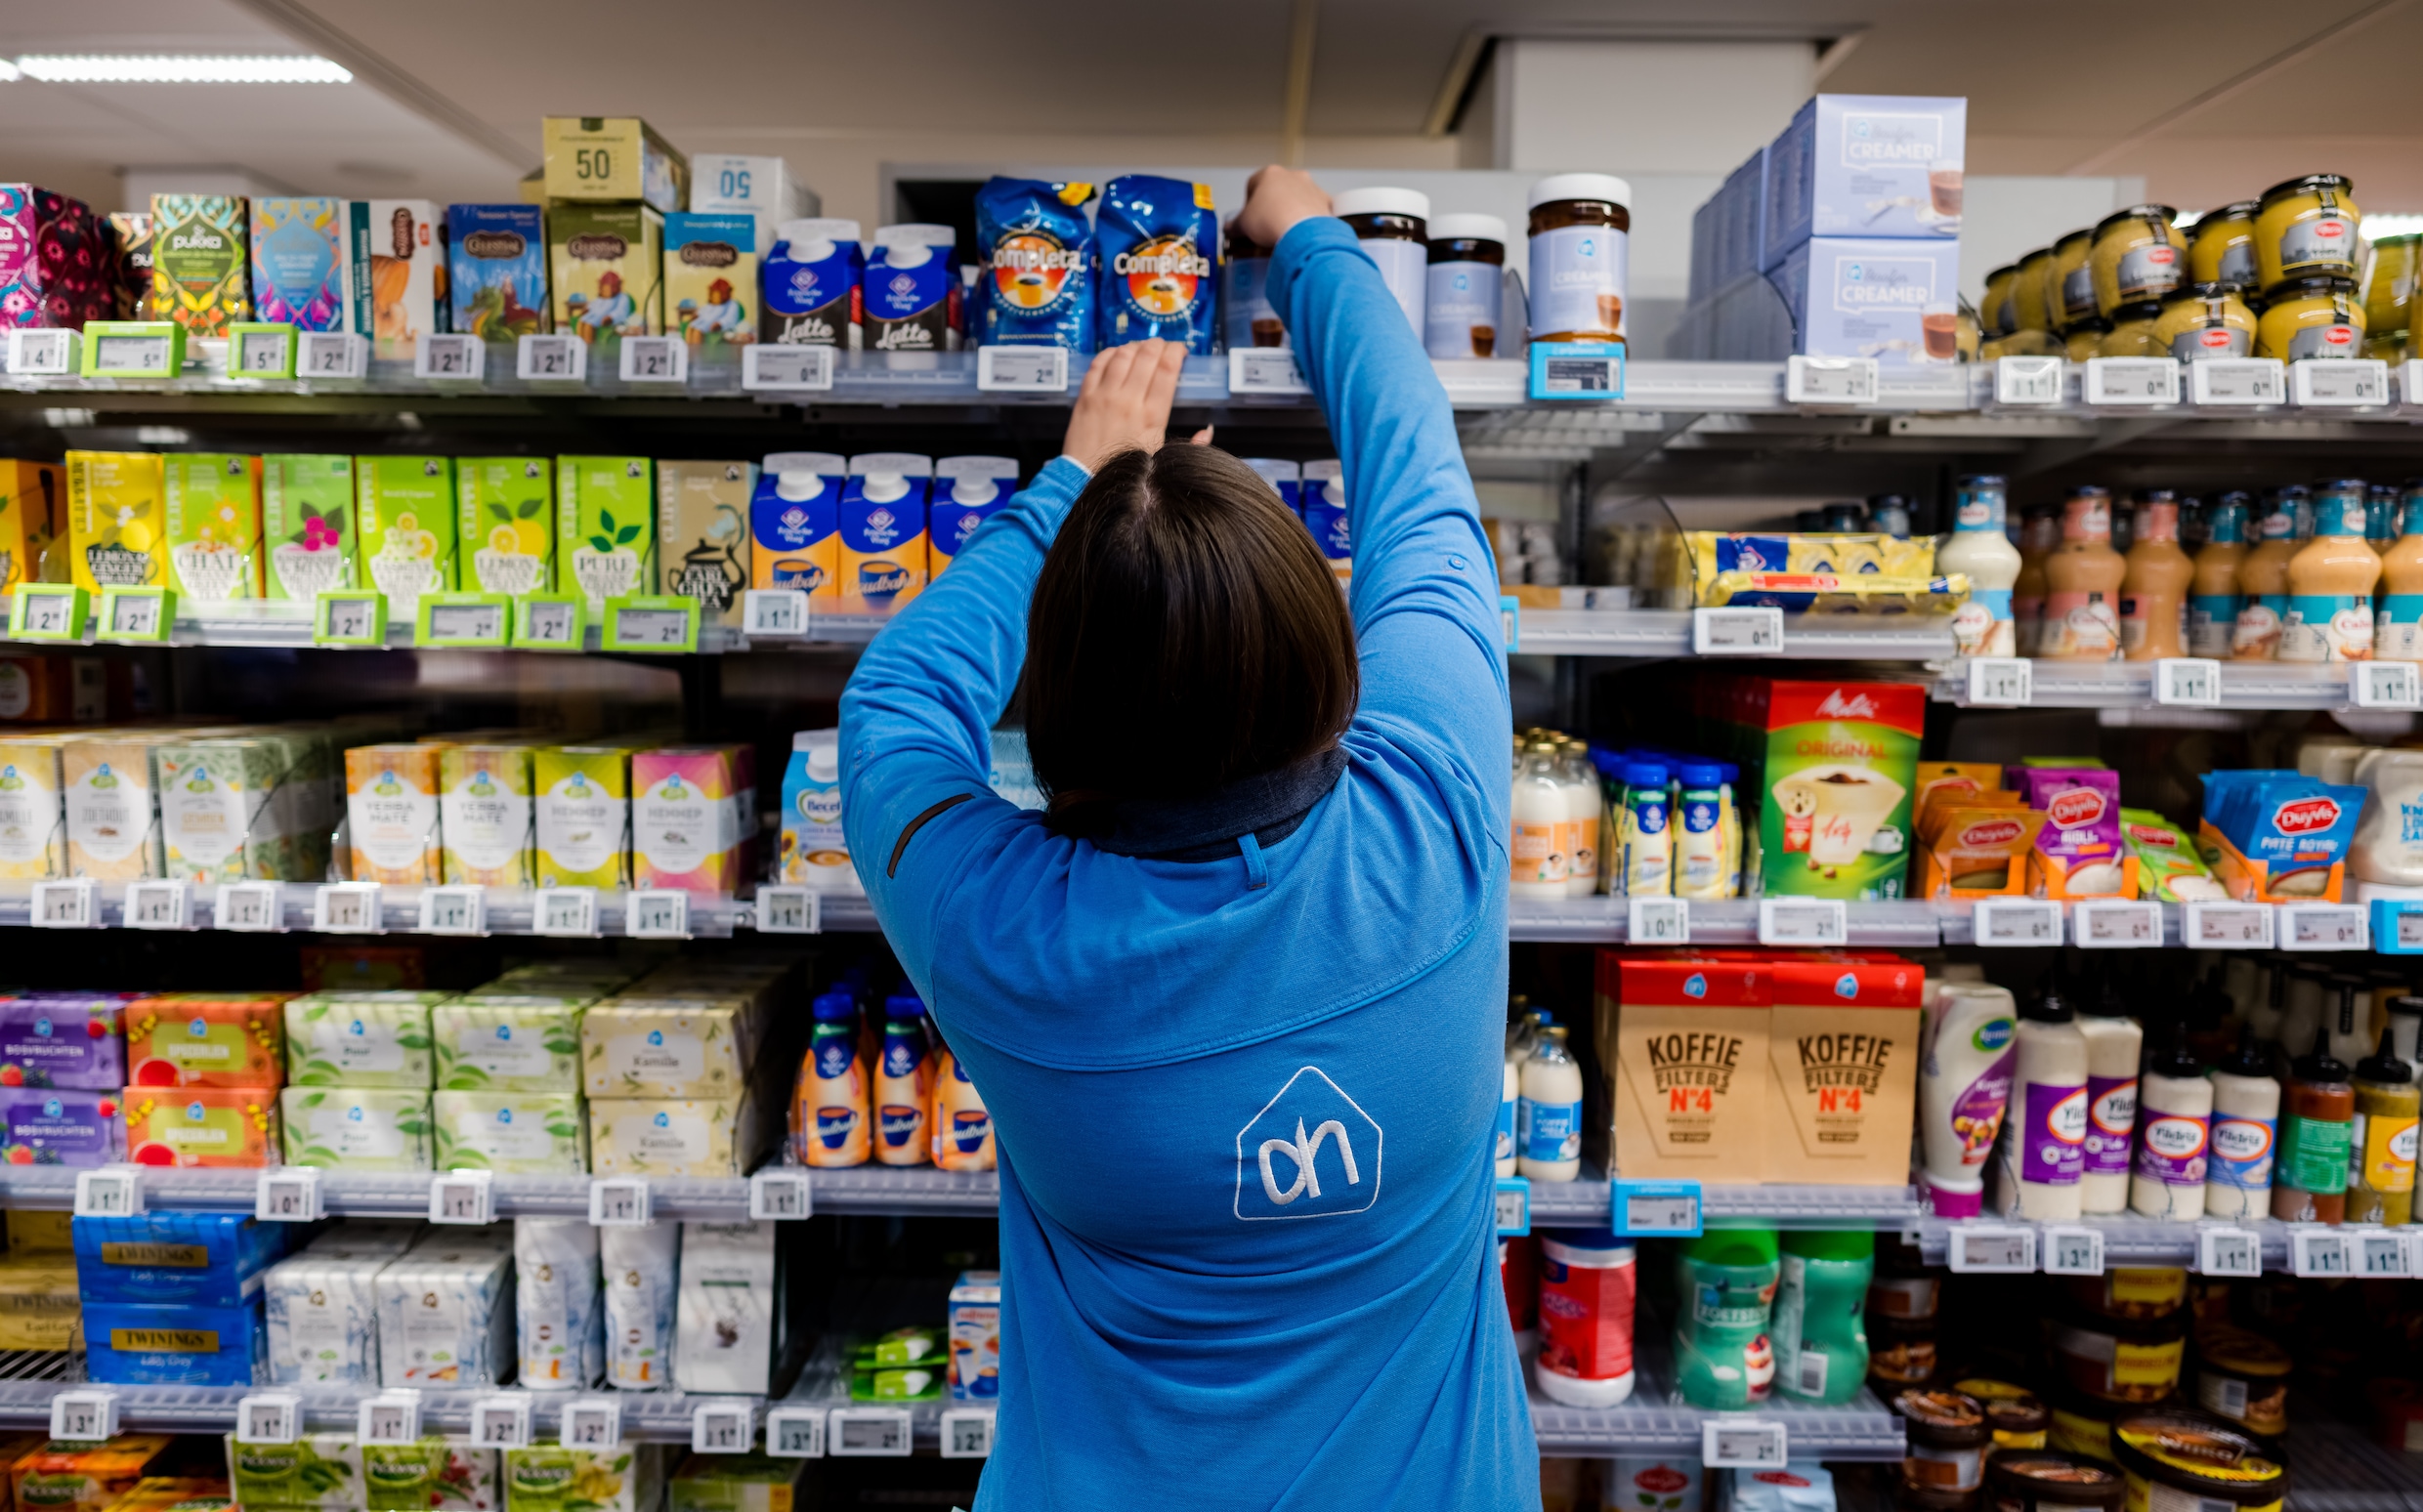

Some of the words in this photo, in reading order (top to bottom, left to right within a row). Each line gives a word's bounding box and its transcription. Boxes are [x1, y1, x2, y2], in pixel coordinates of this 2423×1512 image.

[1849, 142, 1934, 160] CREAMER
[576, 148, 610, 180] 50
[720, 170, 751, 199] 50
[173, 234, 222, 251] pukka
[988, 247, 1082, 273] ompleta
[1114, 251, 1211, 277] Completa
[1842, 285, 1929, 304] CREAMER
[778, 316, 834, 345] Latte
[875, 322, 932, 351] Latte
[178, 553, 234, 568] CHAI
[478, 557, 533, 569] LEMON
[579, 556, 632, 571] PURE
[1814, 688, 1879, 718] Melitta
[1797, 739, 1890, 761] ORIGINAL
[365, 802, 414, 814] YERBA
[459, 802, 508, 814] YERBA
[807, 799, 841, 813] Becel
[2054, 799, 2102, 820] Duyvis
[2401, 802, 2423, 816] KN
[369, 813, 409, 825] MATE
[463, 813, 503, 825] MATE
[2282, 805, 2334, 828] Duyvis
[5, 1044, 85, 1058] BOSVRUCHTEN
[344, 1047, 370, 1057] Puur
[1646, 1032, 1743, 1068] KOFFIE
[1798, 1032, 1893, 1068] KOFFIE
[633, 1054, 680, 1068] Kamille
[1655, 1069, 1731, 1096] FILTERS
[1806, 1070, 1882, 1096] FILTERS
[342, 1133, 369, 1144] Puur
[639, 1136, 686, 1149] Kamille
[1258, 1116, 1359, 1205] ah
[116, 1245, 194, 1262] TWININGS
[13, 1294, 81, 1310] TWINING
[126, 1332, 204, 1348] TWININGS
[367, 1464, 428, 1476] PICKWICK
[513, 1468, 573, 1480] PICKWICK
